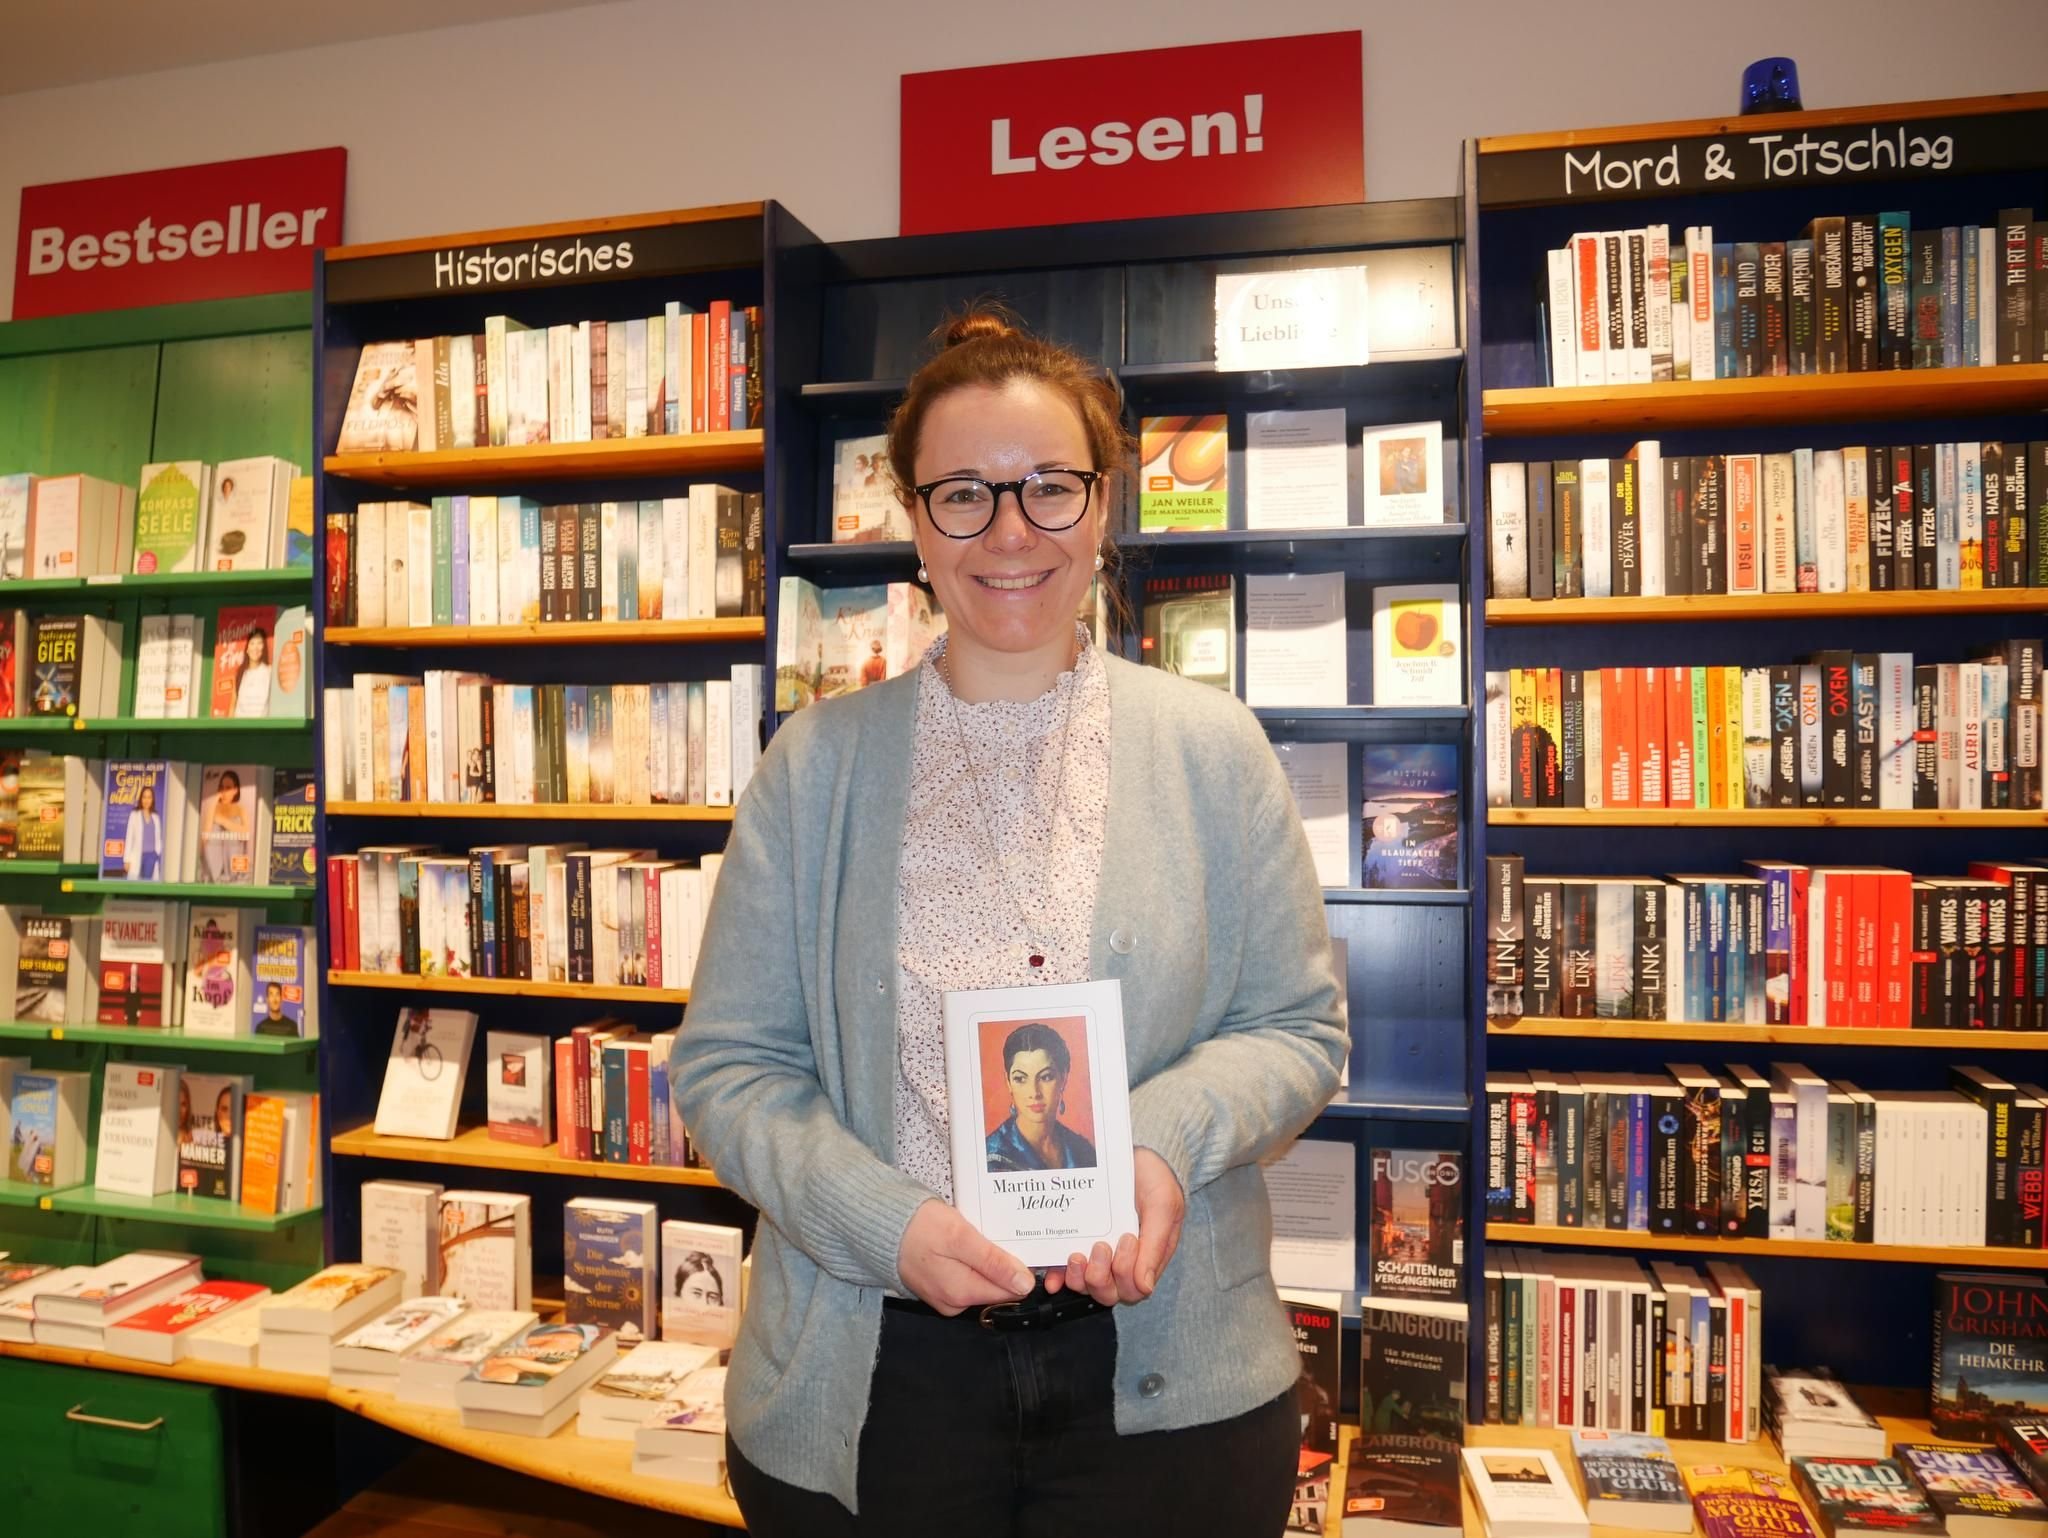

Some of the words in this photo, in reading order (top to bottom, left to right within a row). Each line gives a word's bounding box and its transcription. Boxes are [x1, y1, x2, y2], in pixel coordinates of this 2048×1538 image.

[992, 94, 1263, 175] Lesen!
[1565, 144, 1681, 195] Mord
[1704, 143, 1735, 181] &
[1748, 126, 1954, 180] Totschlag
[28, 202, 328, 276] Bestseller
[1852, 221, 1862, 253] BITCOIN
[1863, 225, 1874, 267] KOMPLOTT
[435, 238, 634, 289] Historisches
[1791, 247, 1809, 296] PATIENTIN
[1825, 231, 1842, 288] UNBEKANNTE
[1853, 255, 1863, 272] DAS
[1884, 228, 1903, 285] OXYGEN
[1922, 245, 1934, 285] Eisnacht
[1738, 262, 1757, 298] BLIND
[1765, 253, 1781, 294] BRUDER
[718, 318, 727, 340] Liebe
[1856, 298, 1864, 332] ANDREAS
[1864, 291, 1873, 339] BRANDHORST
[718, 340, 727, 353] der
[434, 361, 450, 388] Ida
[718, 355, 728, 402] Unteilbarkeit
[718, 403, 728, 416] Die
[1965, 459, 1974, 478] FOX
[2006, 475, 2015, 492] DIE
[2015, 456, 2026, 511] STUDENTIN
[1616, 482, 1624, 498] DER
[1624, 463, 1633, 516] TODESSPIELER
[1699, 478, 1708, 510] MARC
[1708, 470, 1717, 517] ELSBERG
[1773, 462, 1781, 508] ESCHBACH
[1985, 473, 1999, 515] HADES
[139, 498, 194, 513] KOMPASS
[1152, 498, 1173, 507] JAN
[1176, 497, 1214, 507] WEILER
[1965, 480, 1974, 528] CANDICE
[138, 512, 194, 535] SEELE
[1495, 518, 1522, 526] CLANCY
[1849, 502, 1858, 554] SEBASTIAN
[1857, 512, 1865, 543] FITZEK
[1875, 497, 1893, 557] FITZEK
[1922, 507, 1936, 547] FITZEK
[1988, 519, 1998, 535] FOX
[1623, 521, 1634, 568] DEAVER
[1774, 527, 1785, 579] AUSGEBRANNT
[1900, 518, 1913, 558] FITZEK
[1988, 536, 1998, 572] CANDICE
[37, 640, 76, 664] GIER
[2020, 647, 2034, 700] Affenhitze
[1514, 695, 1527, 716] 42
[1802, 684, 1817, 726] OXEN
[1829, 667, 1848, 716] OXEN
[1564, 701, 1573, 739] HARRIS
[1775, 683, 1793, 733] OXEN
[1858, 689, 1874, 744] EAST
[2022, 709, 2032, 729] KOBR
[1575, 700, 1583, 758] VERGELTUNG
[1565, 741, 1574, 781] ROBERT
[1783, 736, 1793, 783] JENSEN
[1808, 735, 1818, 776] JENSEN
[1836, 729, 1846, 767] JENSEN
[1941, 732, 1949, 760] AURIS
[1966, 722, 1978, 770] AURIS
[2022, 733, 2032, 763] KLÜPFEL
[116, 771, 156, 788] Genial
[1862, 749, 1872, 789] JENSEN
[274, 815, 315, 833] TRICK
[1381, 849, 1440, 858] BLAUKALTER
[1404, 840, 1417, 848] IN
[1398, 858, 1424, 867] TIEFE
[1501, 863, 1510, 885] Nacht
[1501, 886, 1511, 923] Einsame
[1645, 891, 1656, 922] Schuld
[2013, 876, 2026, 910] BLUTET
[2034, 884, 2047, 912] LICHT
[104, 920, 158, 943] REVANCHE
[1542, 892, 1552, 940] Schwestern
[1648, 923, 1656, 938] Ohne
[1940, 899, 1957, 945] VANITAS
[1965, 899, 1982, 945] VANITAS
[1989, 899, 2006, 945] VANITAS
[2014, 914, 2026, 945] STILLE
[2032, 915, 2047, 945] BÖSES
[1495, 926, 1516, 980] LINK
[1533, 946, 1550, 988] LINK
[1576, 949, 1590, 987] LINK
[1642, 944, 1660, 990] LINK
[192, 985, 230, 1010] Kopf
[1490, 1103, 1501, 1119] DER
[1516, 1103, 1527, 1117] DER
[1996, 1103, 2009, 1138] COLLEGE
[1490, 1120, 1501, 1139] ZORN
[1516, 1118, 1527, 1145] NEUNTE
[1566, 1108, 1575, 1149] GEHEIMNIS
[2020, 1130, 2030, 1147] Tote
[2032, 1112, 2042, 1149] Wiltshire
[180, 1144, 226, 1164] MÄNNER
[1490, 1141, 1501, 1155] DES
[1516, 1146, 1527, 1163] ARM
[1566, 1149, 1575, 1165] DAS
[1995, 1139, 2007, 1158] DAS
[2020, 1148, 2030, 1164] Der
[2033, 1150, 2041, 1165] von
[993, 1177, 1046, 1195] Martin
[1050, 1176, 1096, 1192] Suter
[1373, 1158, 1460, 1186] FUSCO
[1490, 1157, 1501, 1188] OKTOPUS
[1516, 1164, 1527, 1178] DES
[1016, 1194, 1076, 1213] Melody
[1516, 1179, 1527, 1209] OKTOPUS
[1748, 1169, 1763, 1210] YRSA
[2023, 1170, 2042, 1220] WEBB
[1015, 1229, 1042, 1237] Roman
[1045, 1226, 1079, 1238] Diogenes
[586, 1248, 604, 1260] Die
[1377, 1260, 1437, 1277] SCHATTEN
[1438, 1268, 1455, 1278] DER
[573, 1262, 631, 1279] Symphonie
[1375, 1273, 1458, 1289] VERGANGENHEIT
[594, 1281, 613, 1293] der
[1951, 1285, 2048, 1318] JOHN
[585, 1296, 621, 1310] Sterne
[1369, 1309, 1466, 1344] LANGROTH
[1959, 1354, 2046, 1373] HEIMKEHR
[1989, 1342, 2016, 1356] DIE
[1586, 1467, 1667, 1481] MORD
[1804, 1462, 1903, 1486] COLD
[1906, 1449, 2009, 1473] COLD
[1611, 1478, 1677, 1492] CLUB
[1706, 1504, 1791, 1520] MORD
[1734, 1516, 1803, 1535] CLUB
